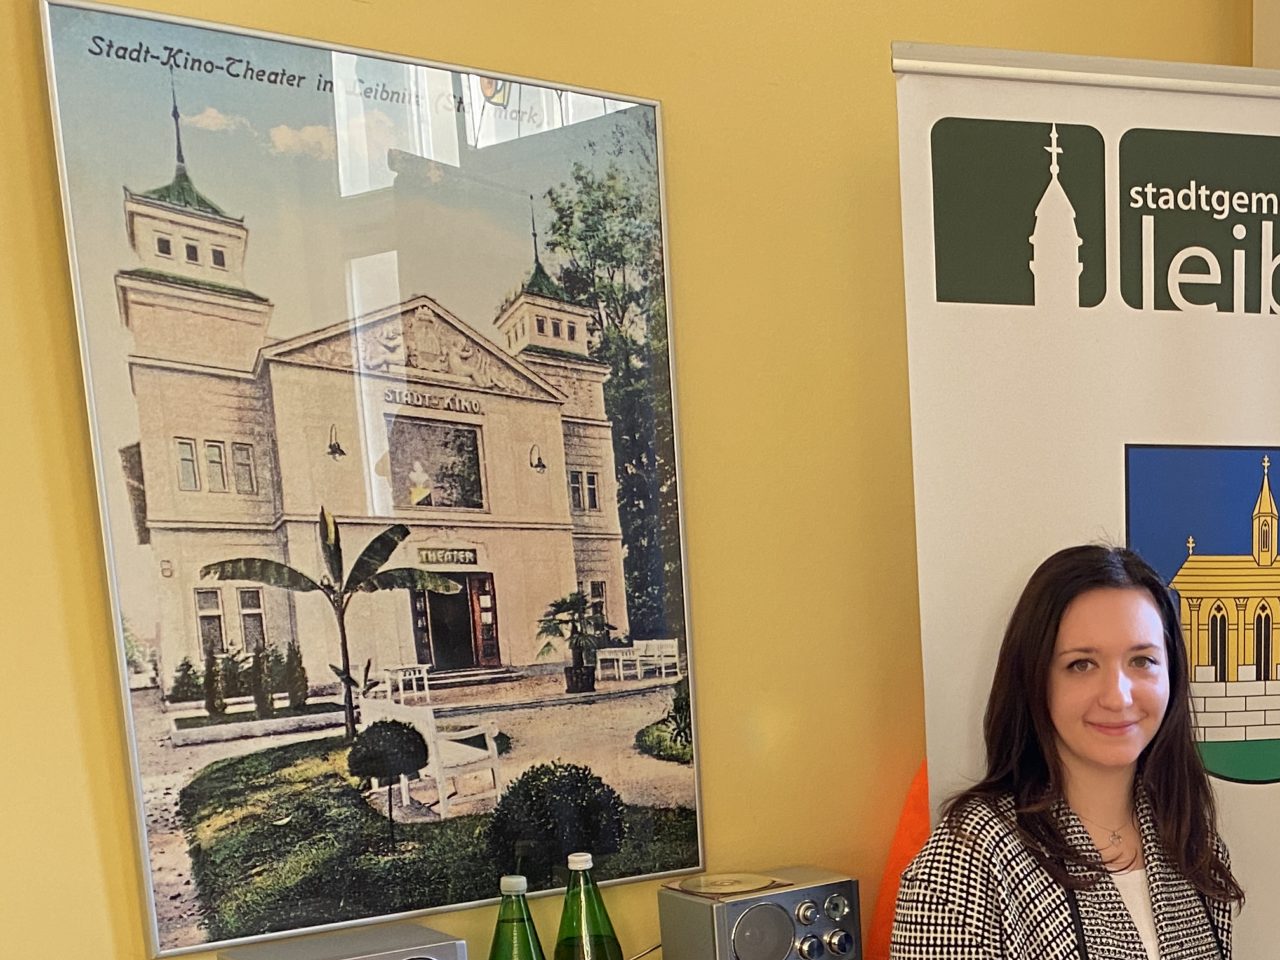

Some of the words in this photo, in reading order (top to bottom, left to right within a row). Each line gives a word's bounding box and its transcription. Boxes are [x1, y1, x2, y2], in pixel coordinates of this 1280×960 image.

[87, 35, 306, 89] Stadt-Kino-Theater
[316, 73, 334, 93] in
[420, 549, 475, 563] THEATER
